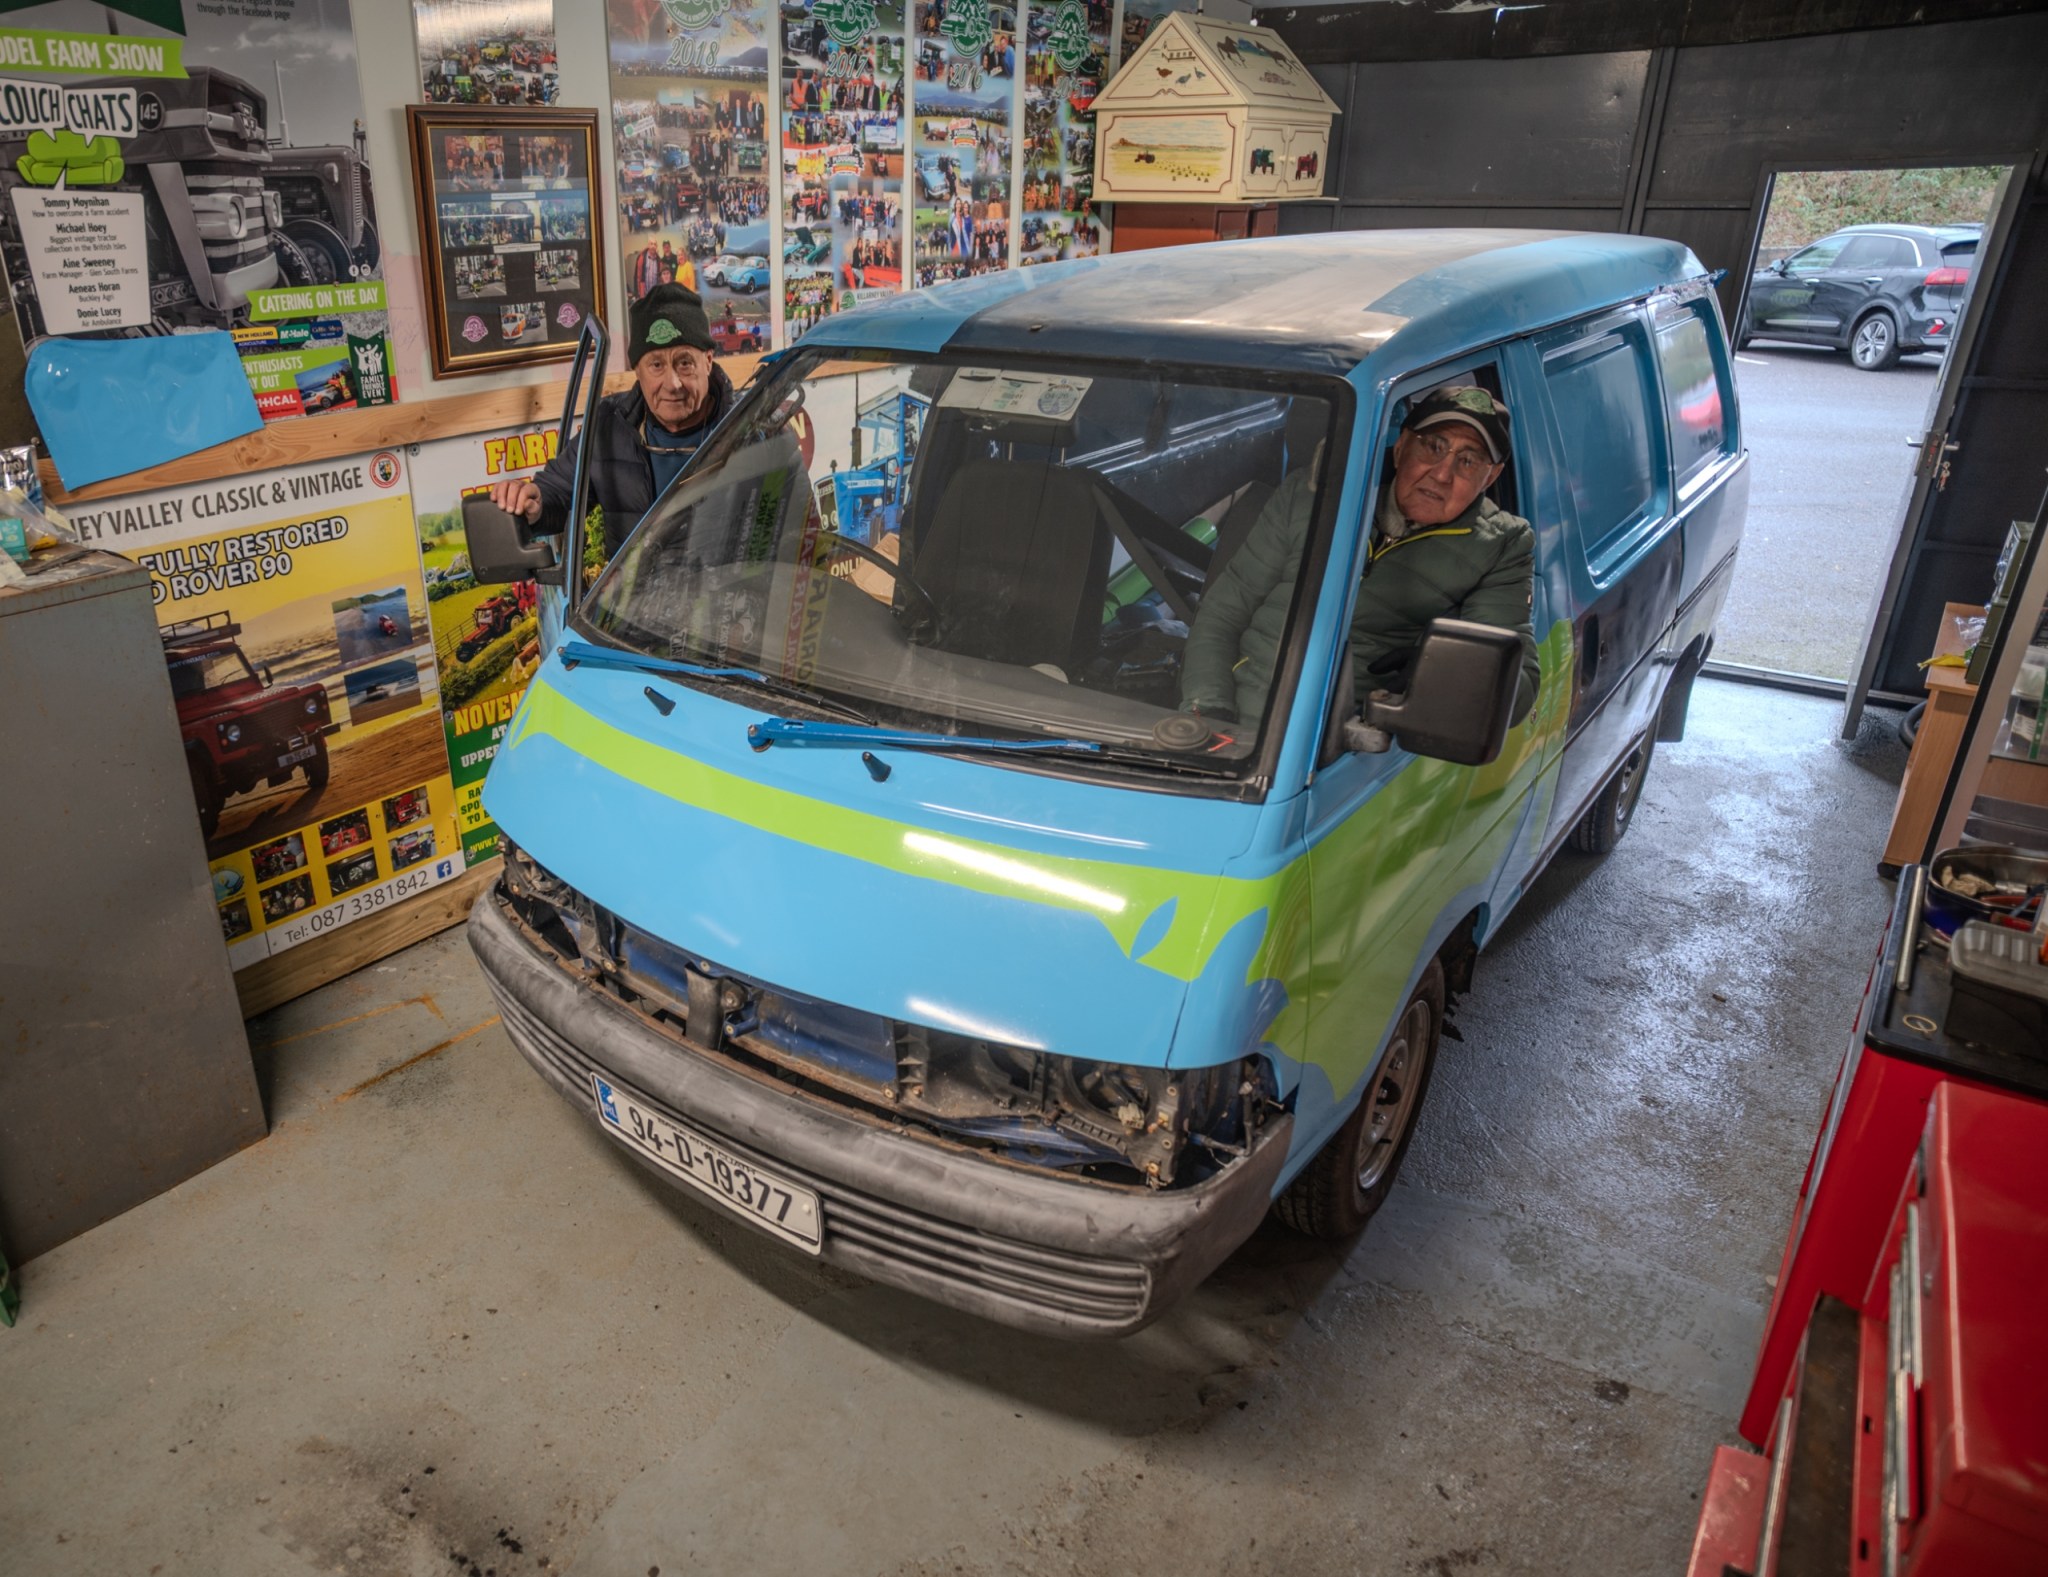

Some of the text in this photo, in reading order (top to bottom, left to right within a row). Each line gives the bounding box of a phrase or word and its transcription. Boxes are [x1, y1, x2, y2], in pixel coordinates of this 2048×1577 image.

[197, 2, 291, 21] through the facebook page
[46, 39, 102, 68] FARM
[105, 42, 164, 72] SHOW
[666, 36, 720, 69] 2018
[825, 50, 868, 78] 2017
[949, 63, 984, 90] 2016
[67, 93, 133, 133] CHATS
[139, 103, 158, 121] 145
[41, 196, 110, 209] Tommy Moynihan
[32, 210, 45, 218] How
[106, 208, 130, 216] accident
[56, 222, 107, 234] Michael Hoey
[49, 236, 72, 245] Biggest
[74, 235, 96, 243] vintage
[44, 245, 72, 254] collection
[81, 244, 91, 252] the
[93, 243, 112, 251] British
[62, 258, 116, 268] Aine Sweeney
[42, 271, 57, 279] Farm
[59, 270, 83, 280] Manager
[89, 269, 103, 277] Glen
[103, 268, 120, 276] South
[121, 267, 138, 275] Farms
[69, 282, 121, 294] Aeneas Horan
[78, 294, 101, 303] Buckley
[259, 287, 378, 313] CATERING ON THE DAY
[77, 307, 122, 318] Donie Lucey
[92, 318, 122, 326] Ambulance
[261, 374, 280, 389] OUT
[360, 374, 384, 385] FAMILY
[362, 388, 386, 399] EVENT
[107, 498, 184, 535] VALLEY
[192, 485, 268, 519] CLASSIC
[271, 481, 287, 503] &
[290, 466, 364, 500] VINTAGE
[138, 515, 348, 577] FULLY RESTORED
[170, 559, 260, 601] ROVER
[260, 552, 293, 580] 90
[467, 812, 481, 825] TO
[285, 870, 429, 944] Tel: 087 3381842
[628, 1105, 793, 1223] 94-D-19377
